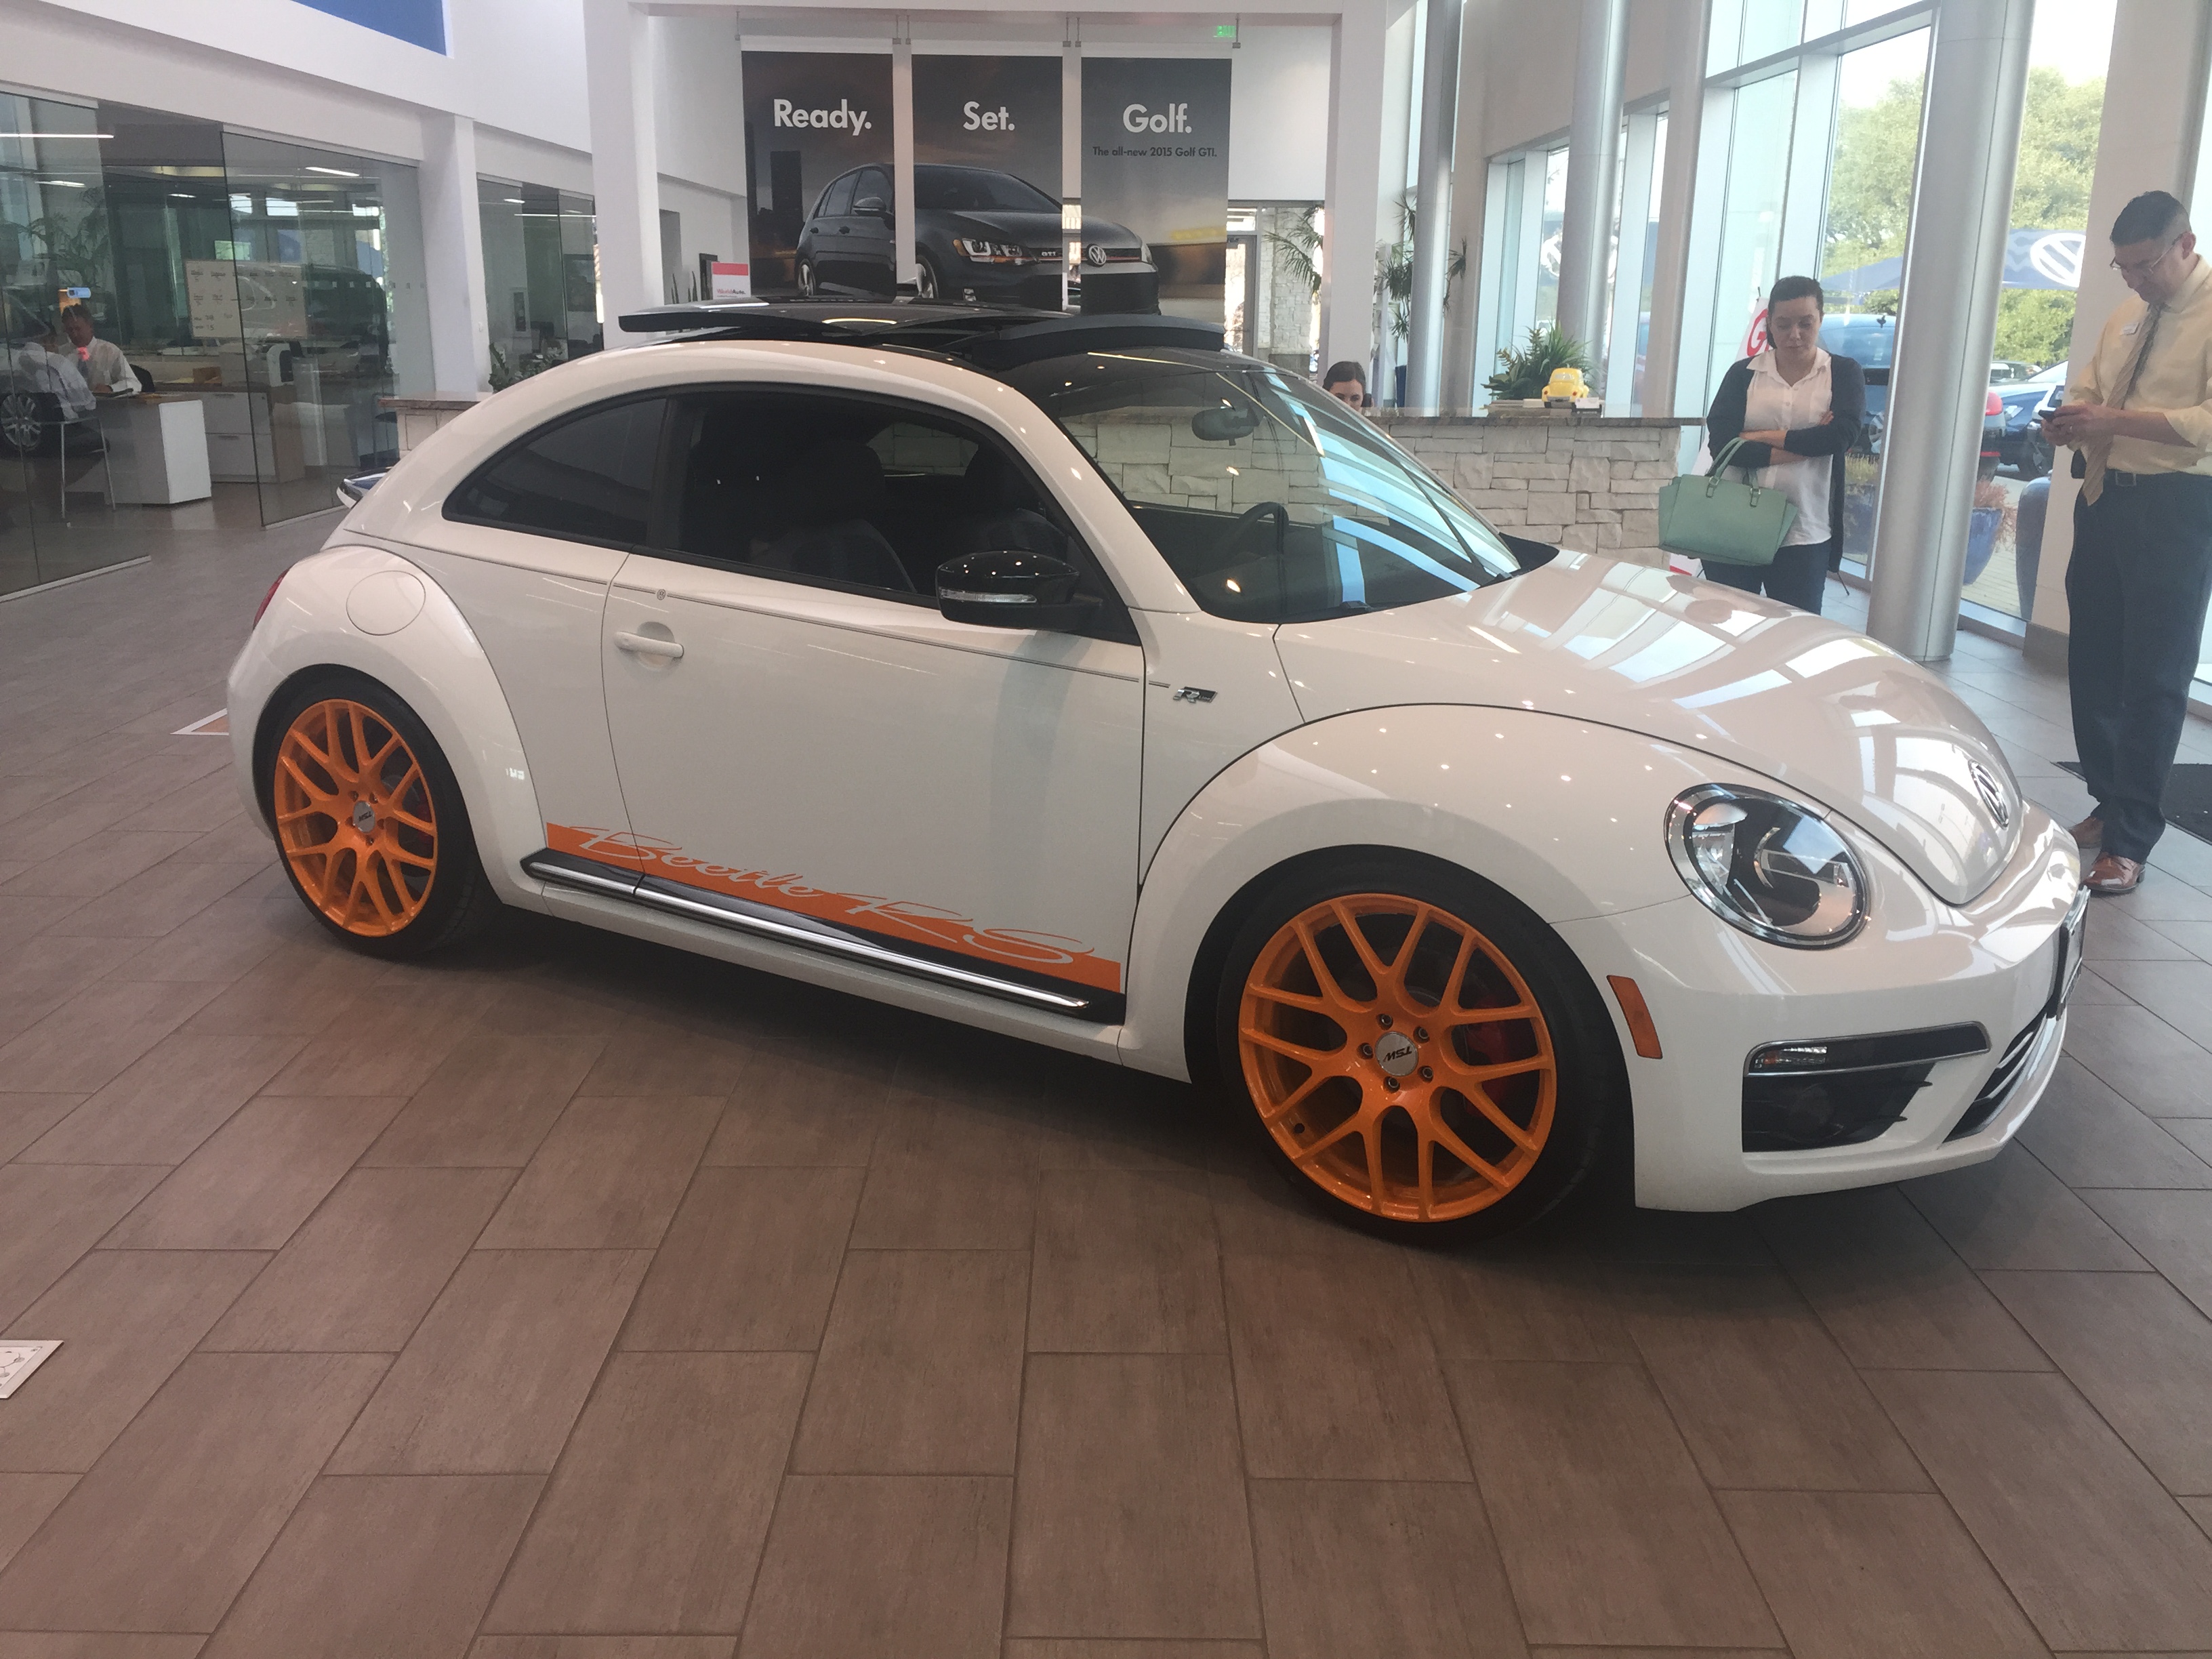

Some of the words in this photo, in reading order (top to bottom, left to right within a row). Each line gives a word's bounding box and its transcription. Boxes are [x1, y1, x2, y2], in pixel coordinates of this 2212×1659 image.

[773, 98, 872, 136] Ready.
[963, 101, 1015, 131] Set.
[1123, 103, 1192, 134] Golf.
[1092, 146, 1109, 157] The
[1111, 146, 1147, 157] all-new
[1149, 146, 1173, 157] 2015
[1174, 146, 1196, 158] Golf
[1197, 147, 1218, 158] GTI.
[569, 825, 824, 898] Beetle
